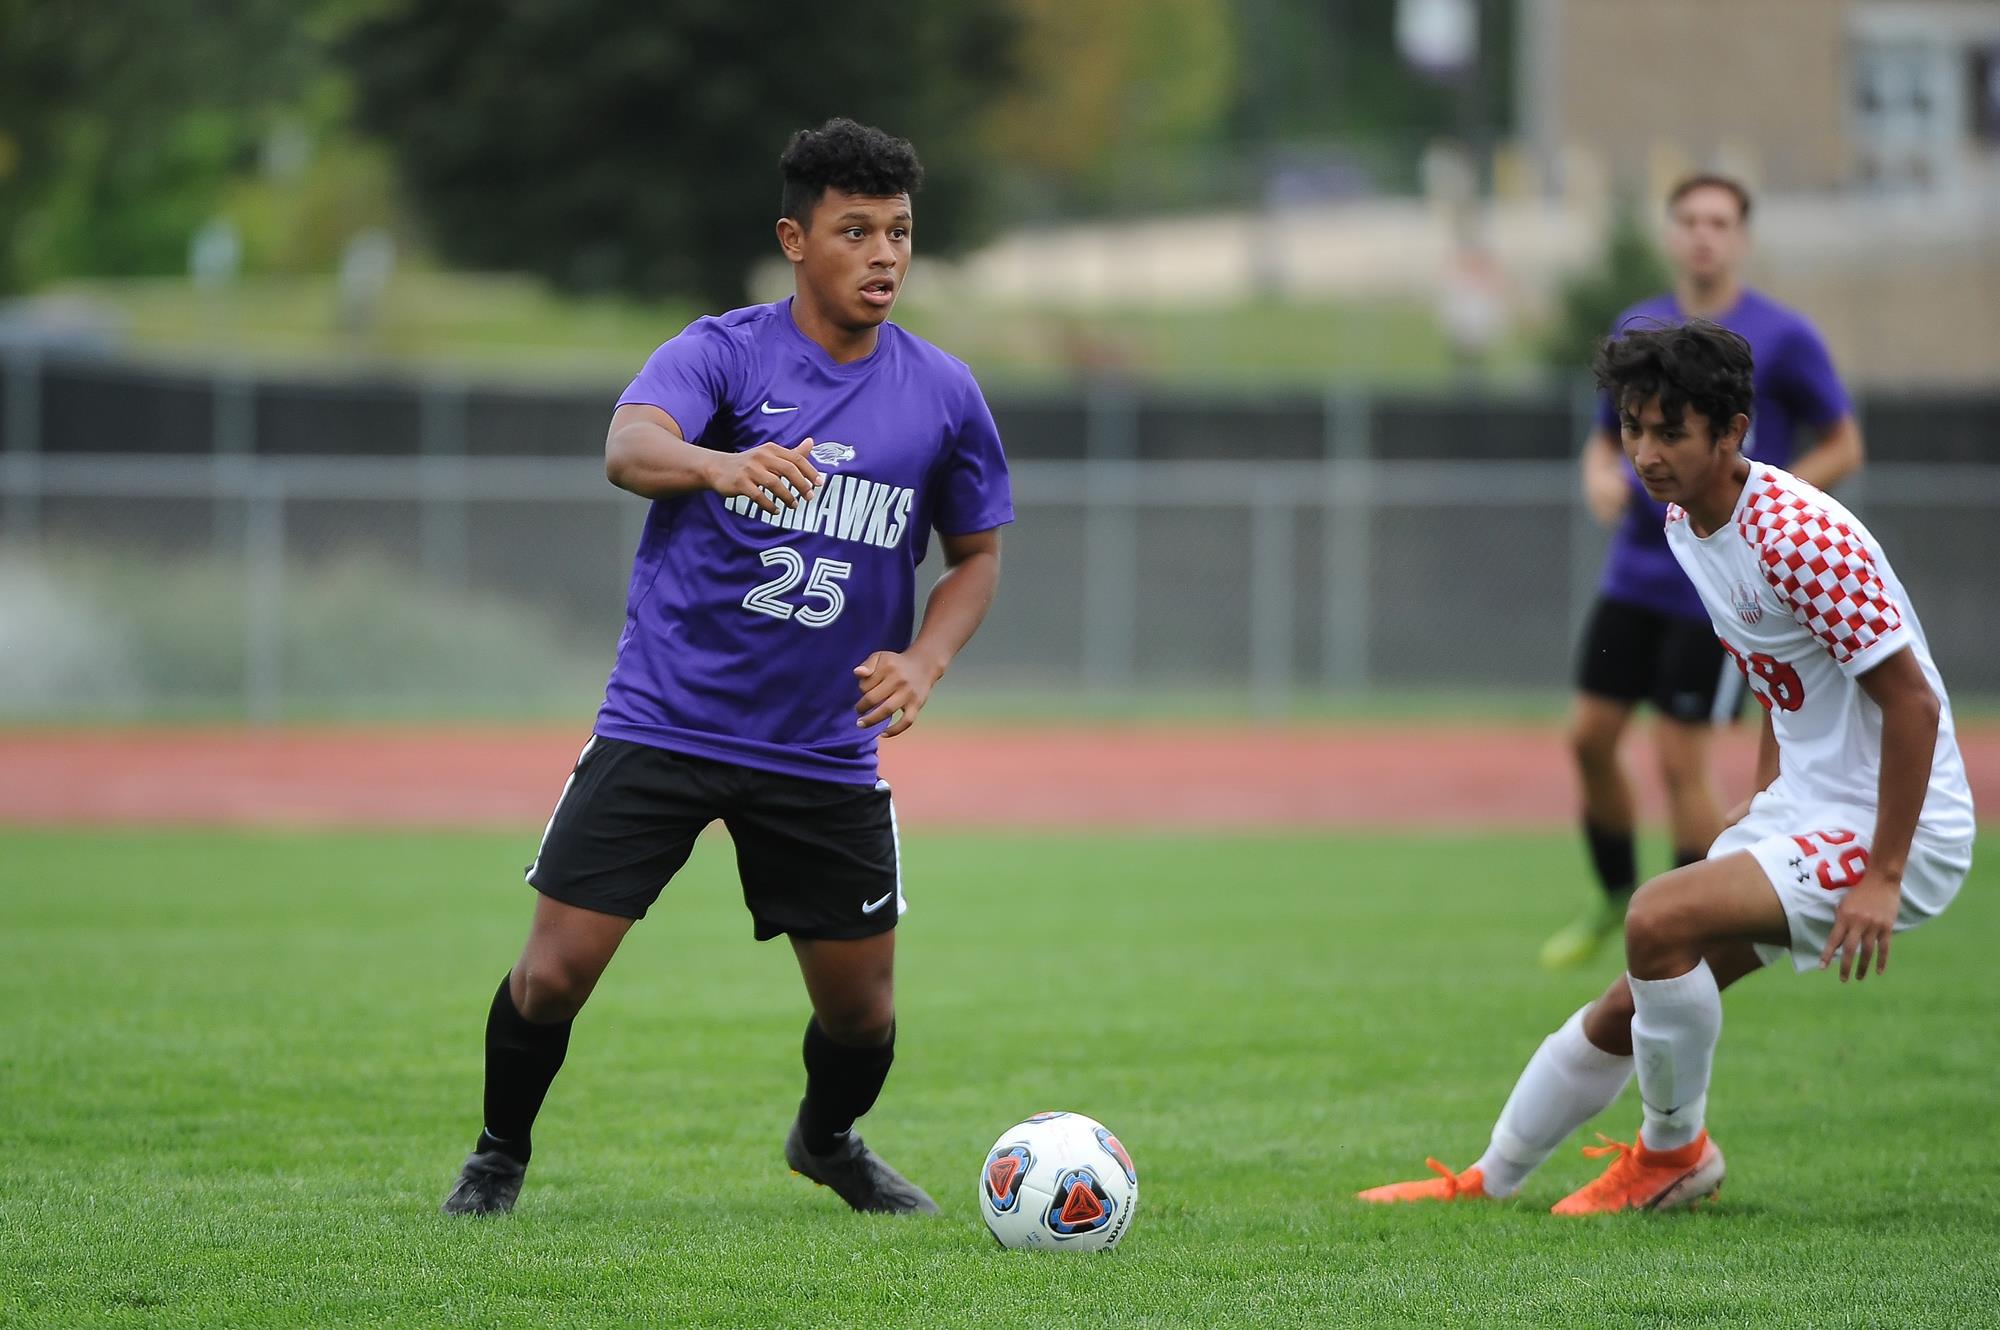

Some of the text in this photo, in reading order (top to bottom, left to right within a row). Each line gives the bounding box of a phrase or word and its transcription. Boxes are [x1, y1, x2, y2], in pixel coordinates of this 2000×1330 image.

[742, 546, 852, 627] 25
[1790, 828, 1869, 891] 29
[1104, 1195, 1131, 1244] Wilson
